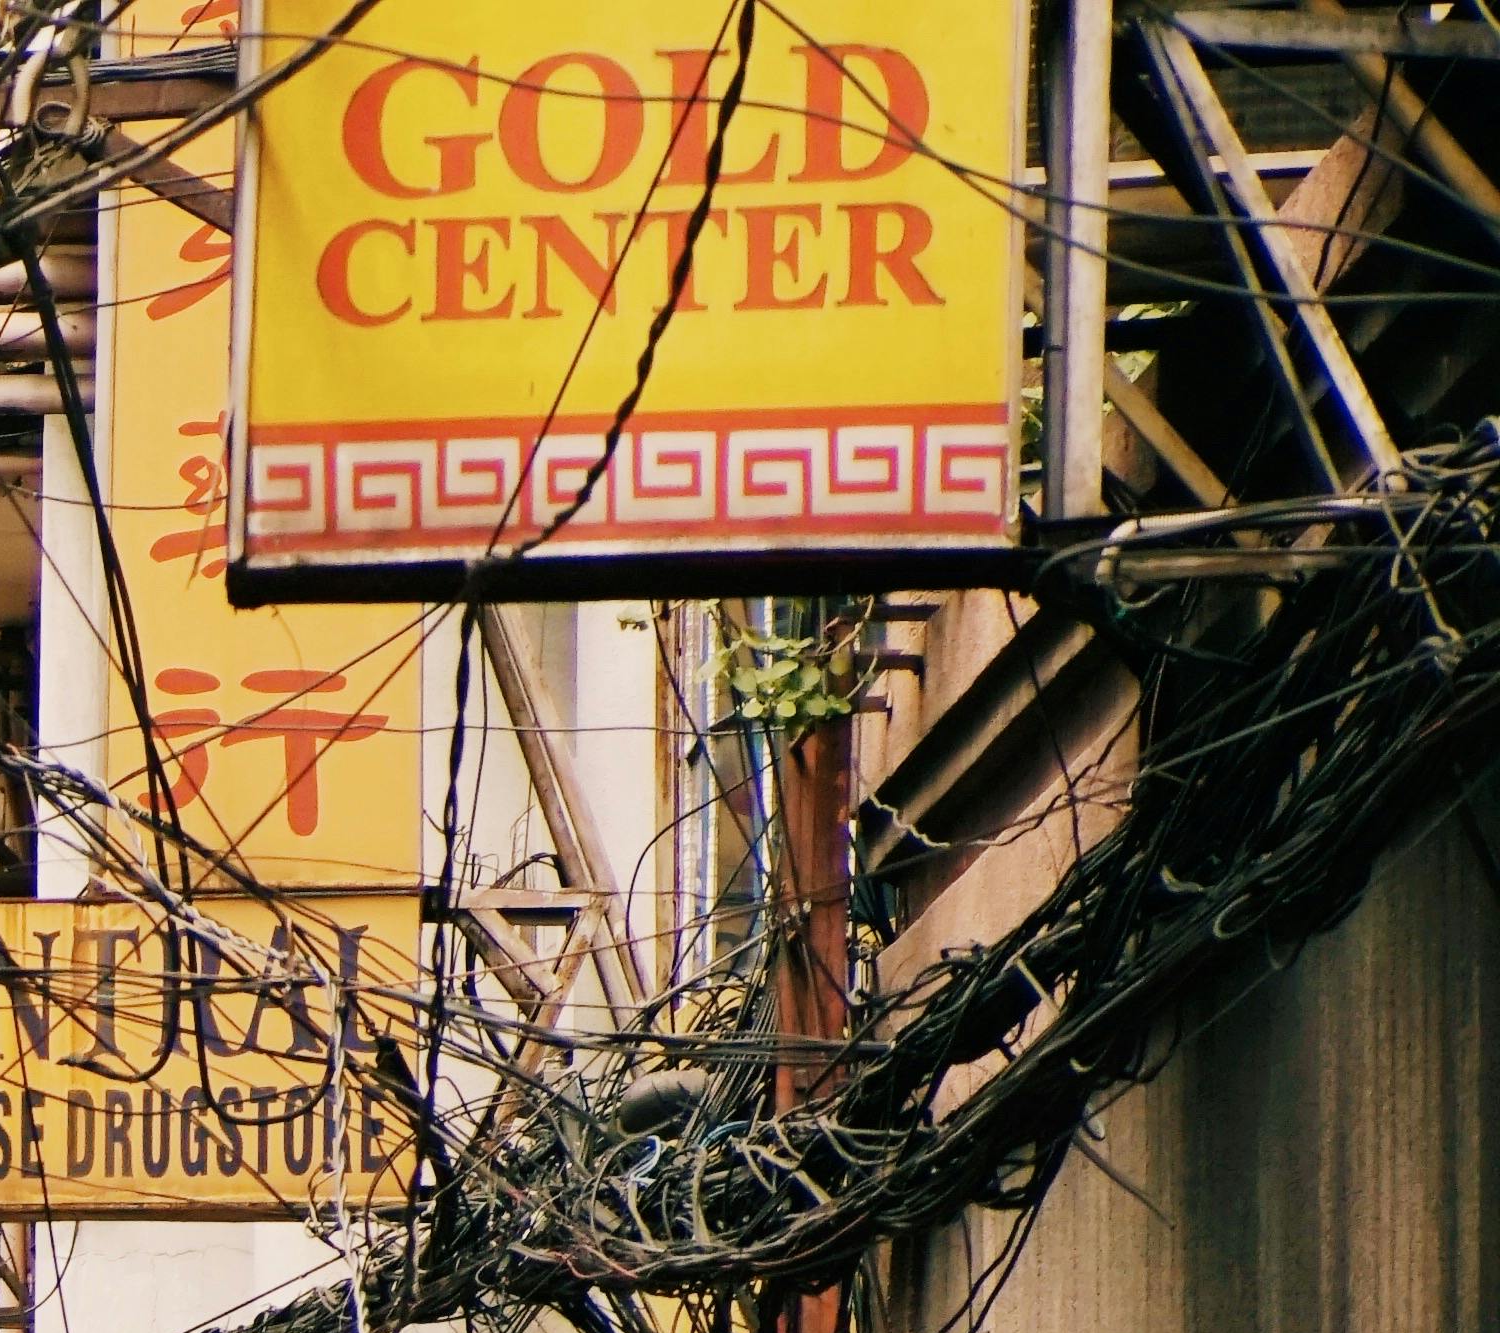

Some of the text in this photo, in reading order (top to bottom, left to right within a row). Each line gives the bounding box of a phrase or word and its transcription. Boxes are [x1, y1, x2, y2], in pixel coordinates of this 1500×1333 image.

[342, 42, 930, 198] GOLD
[316, 202, 944, 328] CENTER
[67, 1083, 385, 1182] DRUGSTORE
